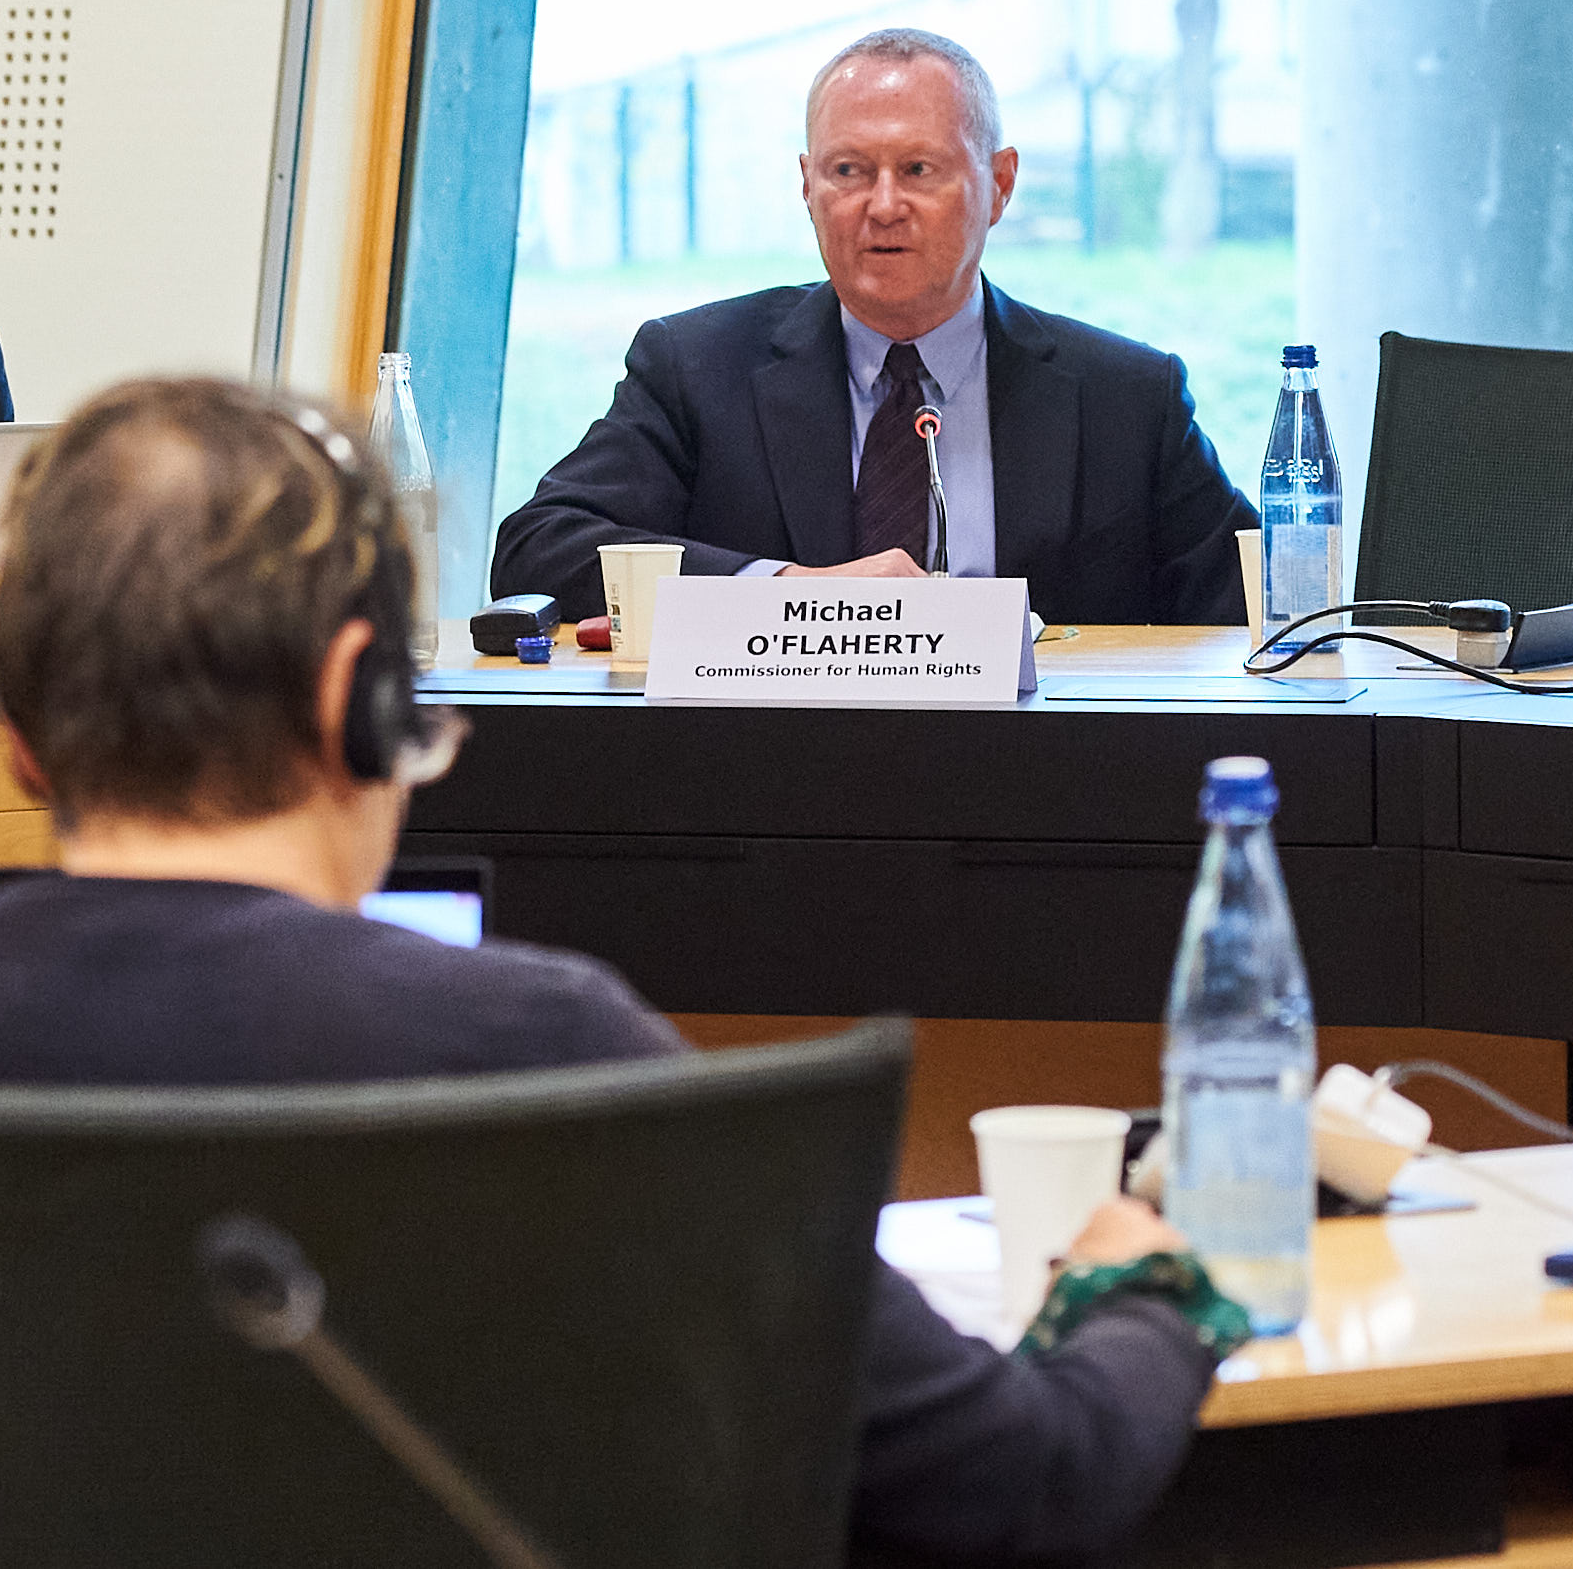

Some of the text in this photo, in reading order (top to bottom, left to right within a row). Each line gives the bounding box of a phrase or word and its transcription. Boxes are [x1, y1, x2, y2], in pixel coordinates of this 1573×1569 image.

[783, 599, 902, 622] Michael
[747, 633, 945, 656] O'FLAHERTY
[694, 662, 982, 678] Commissioner for Human Rights
